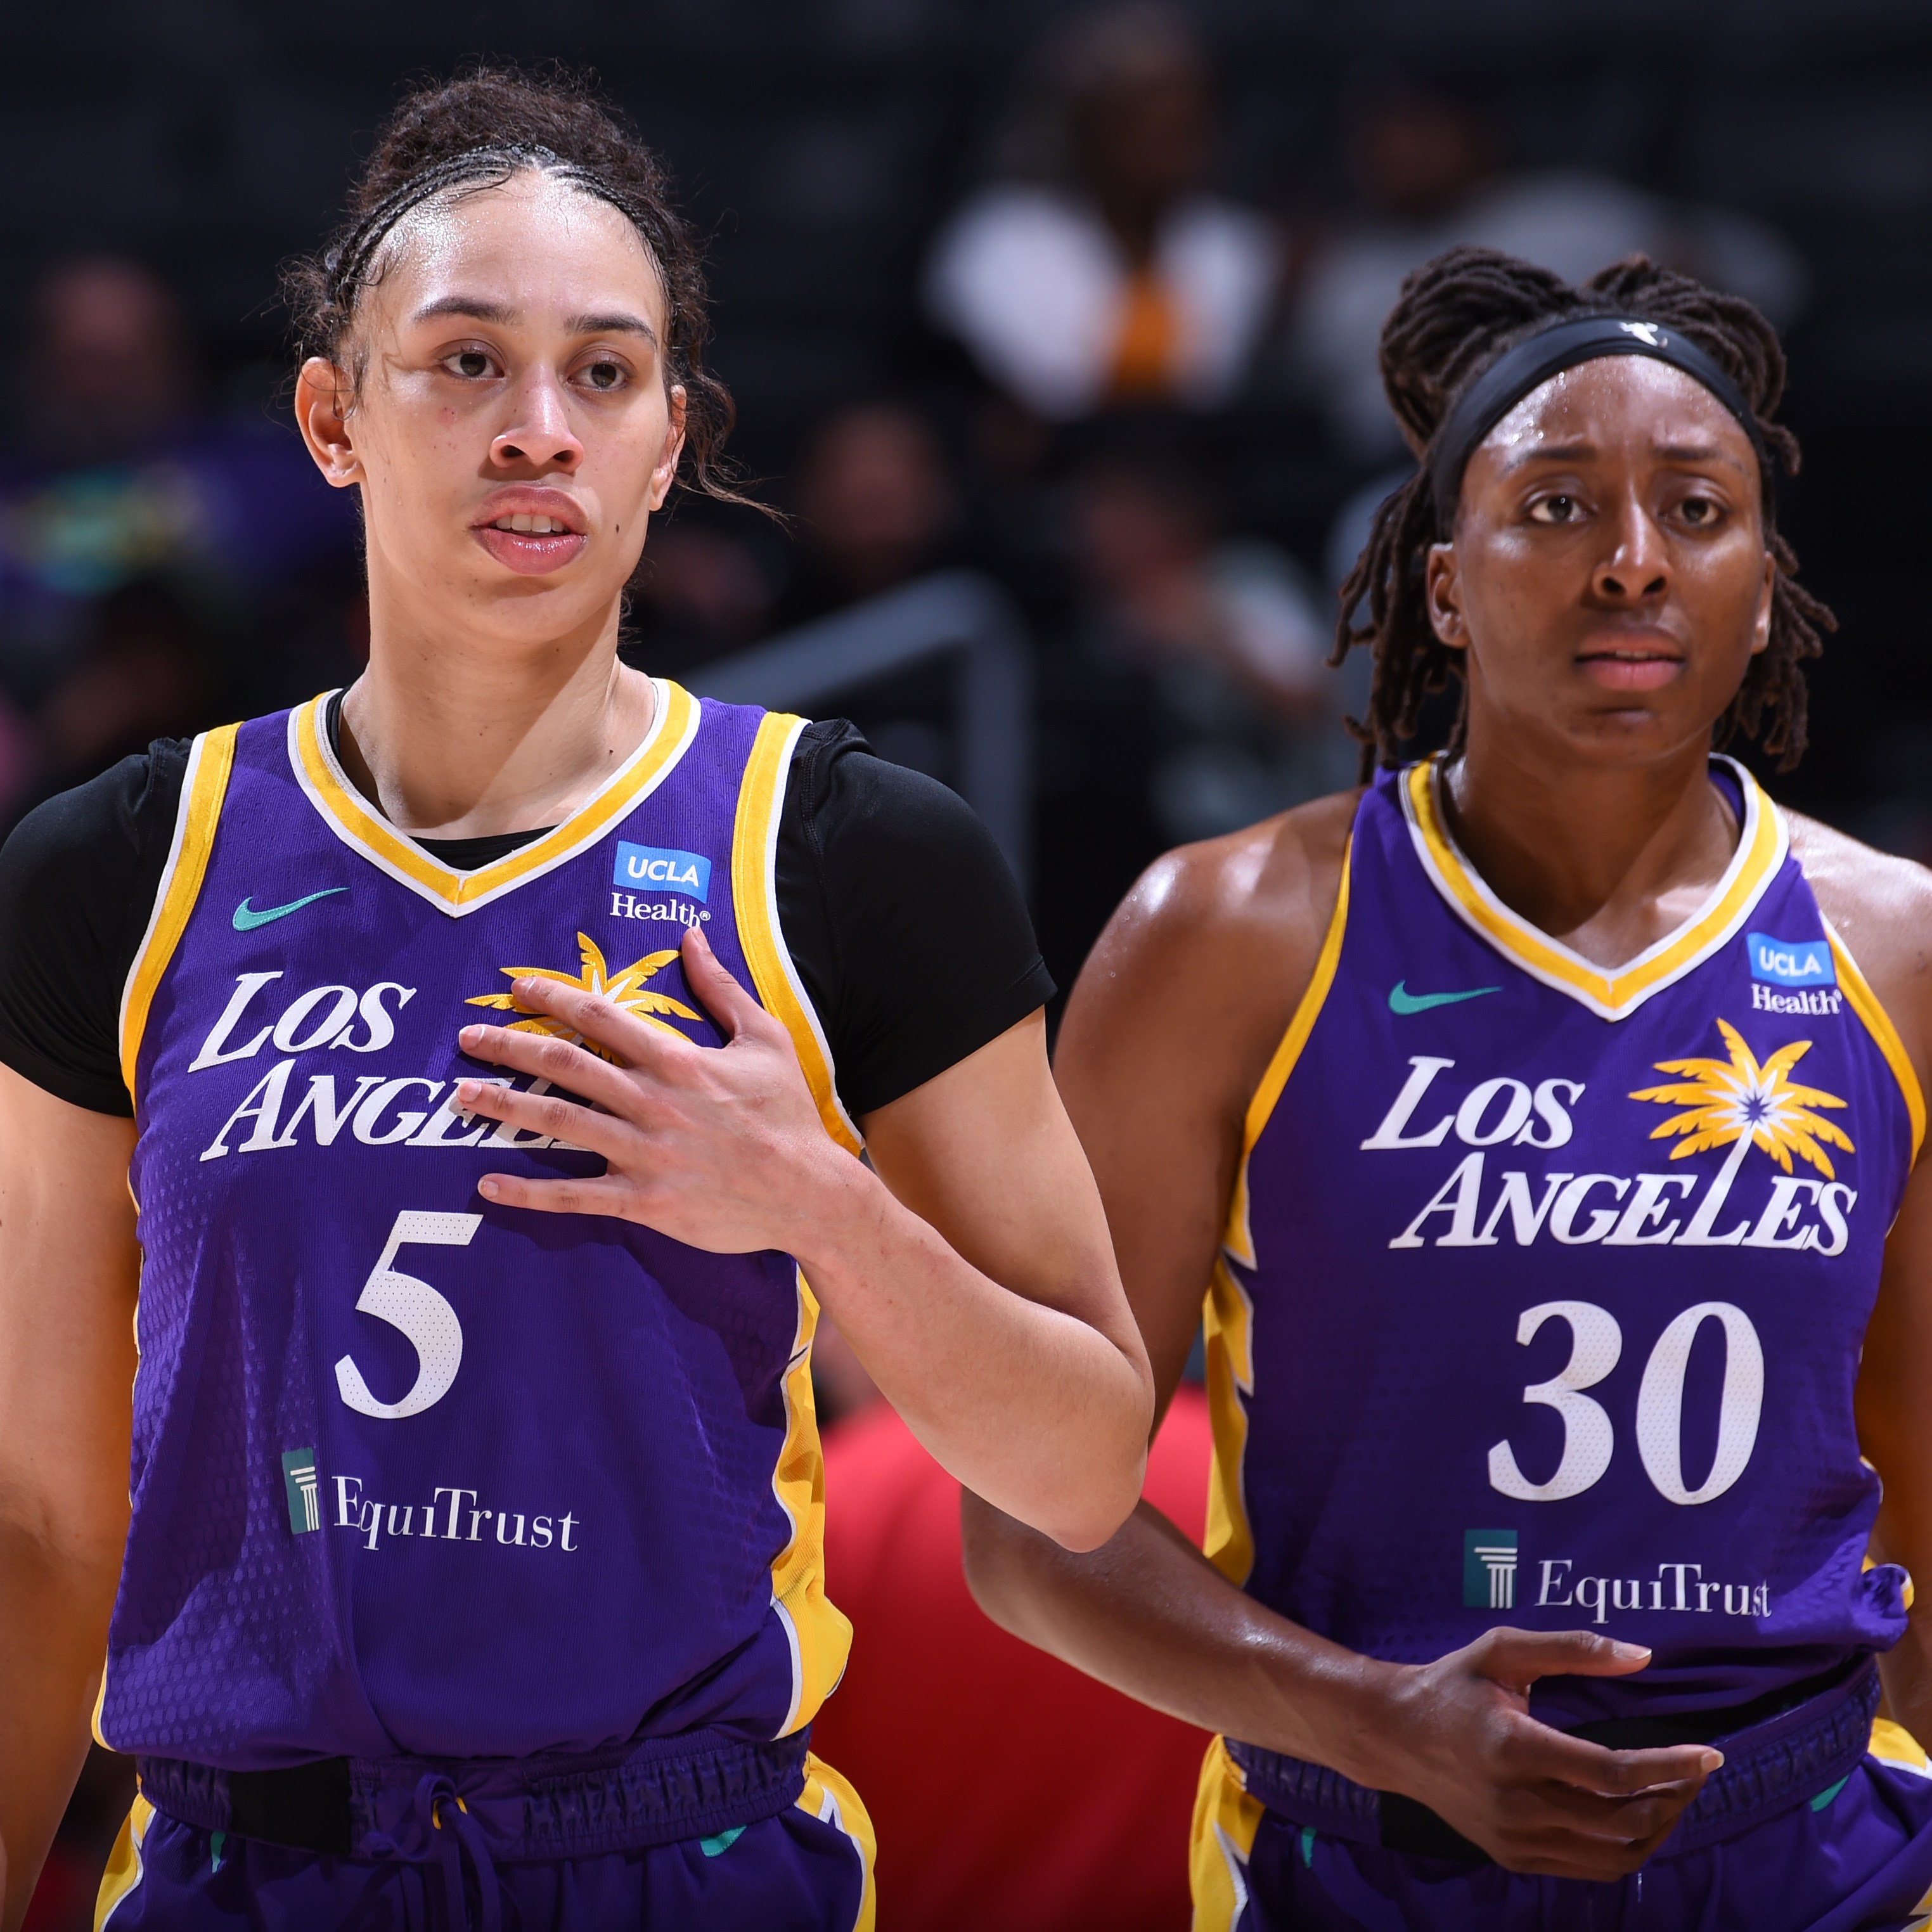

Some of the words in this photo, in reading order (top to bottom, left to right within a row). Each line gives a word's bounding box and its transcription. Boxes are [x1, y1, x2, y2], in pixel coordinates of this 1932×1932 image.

[628, 856, 699, 887] UCLA
[1759, 946, 1822, 977] UCLA
[187, 970, 418, 1073] LOS
[1360, 1055, 1586, 1150] LOS
[1388, 1150, 1858, 1257] ANGELES
[335, 1209, 484, 1419] 5
[1487, 1300, 1765, 1505] 30
[331, 1476, 580, 1552] EquiTrust
[1533, 1559, 1773, 1624] EquiTrust
